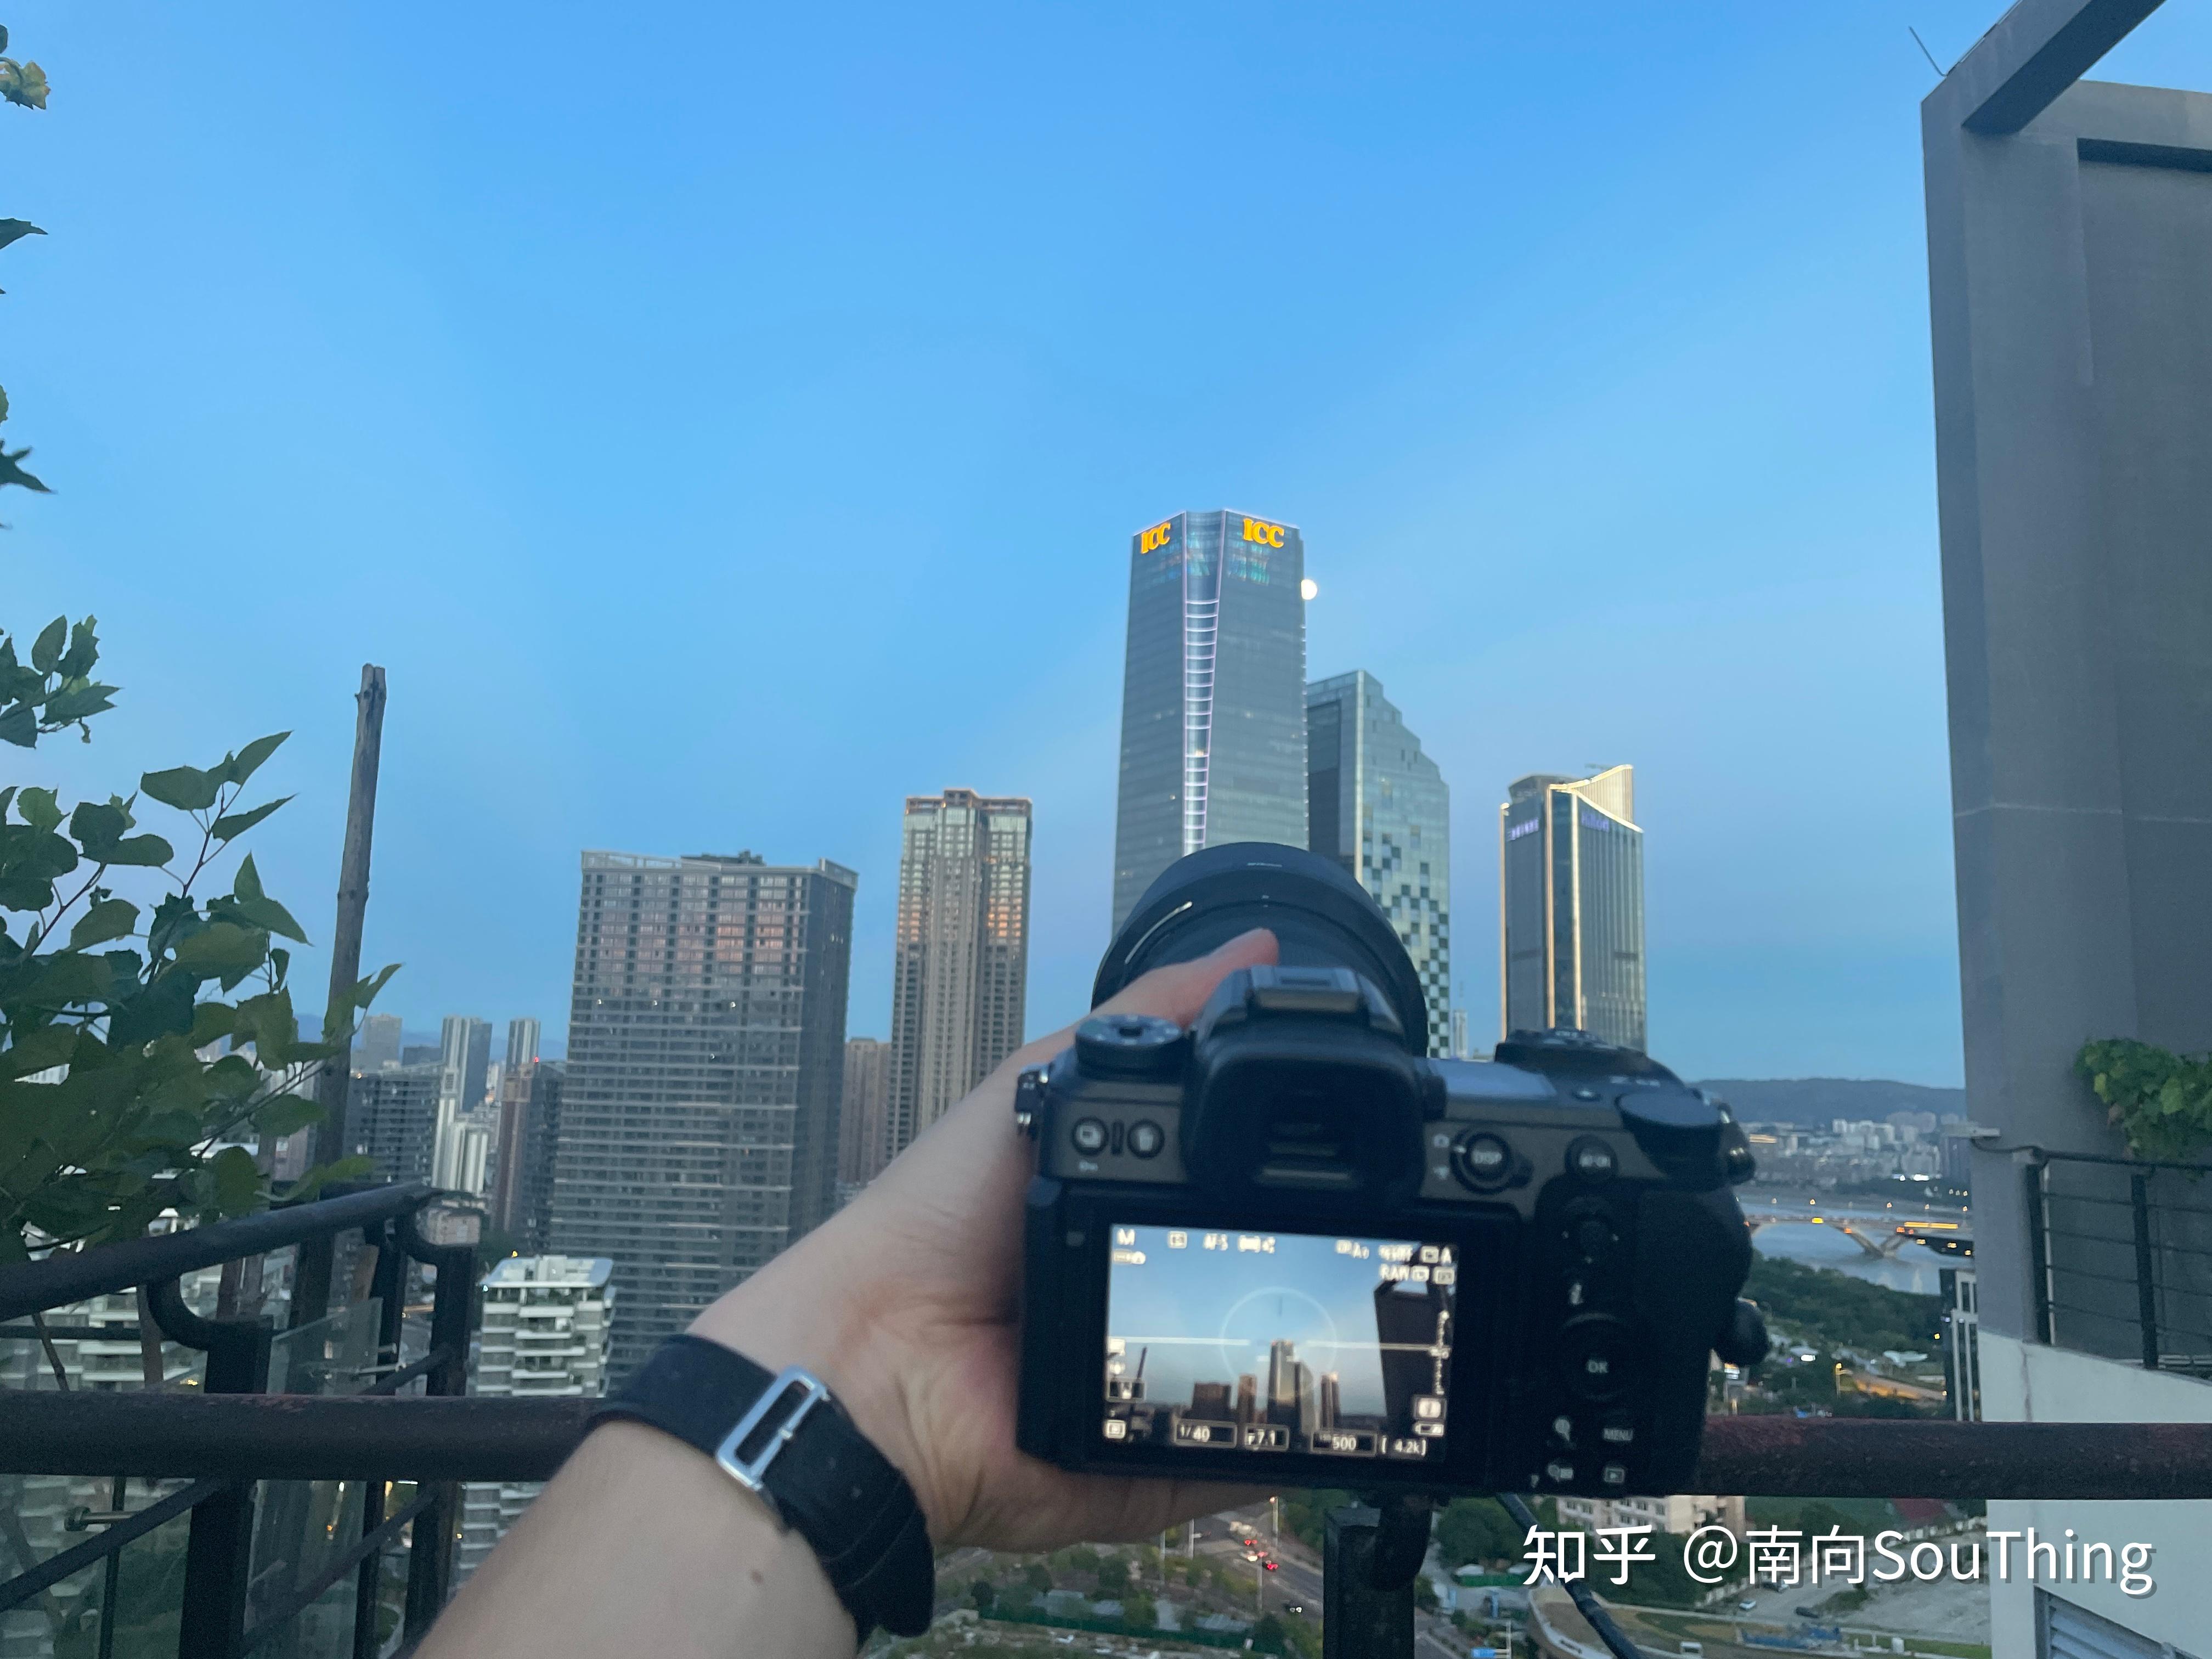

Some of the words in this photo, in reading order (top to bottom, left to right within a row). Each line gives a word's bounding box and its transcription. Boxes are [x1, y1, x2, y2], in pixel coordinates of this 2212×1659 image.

[1141, 522, 1171, 554] ICC
[1243, 518, 1284, 548] ICC
[1118, 1228, 1135, 1245] M
[1379, 1263, 1410, 1281] RAW
[1587, 1359, 1607, 1373] OK
[1180, 1424, 1210, 1442] 1/40
[1333, 1434, 1357, 1451] 500
